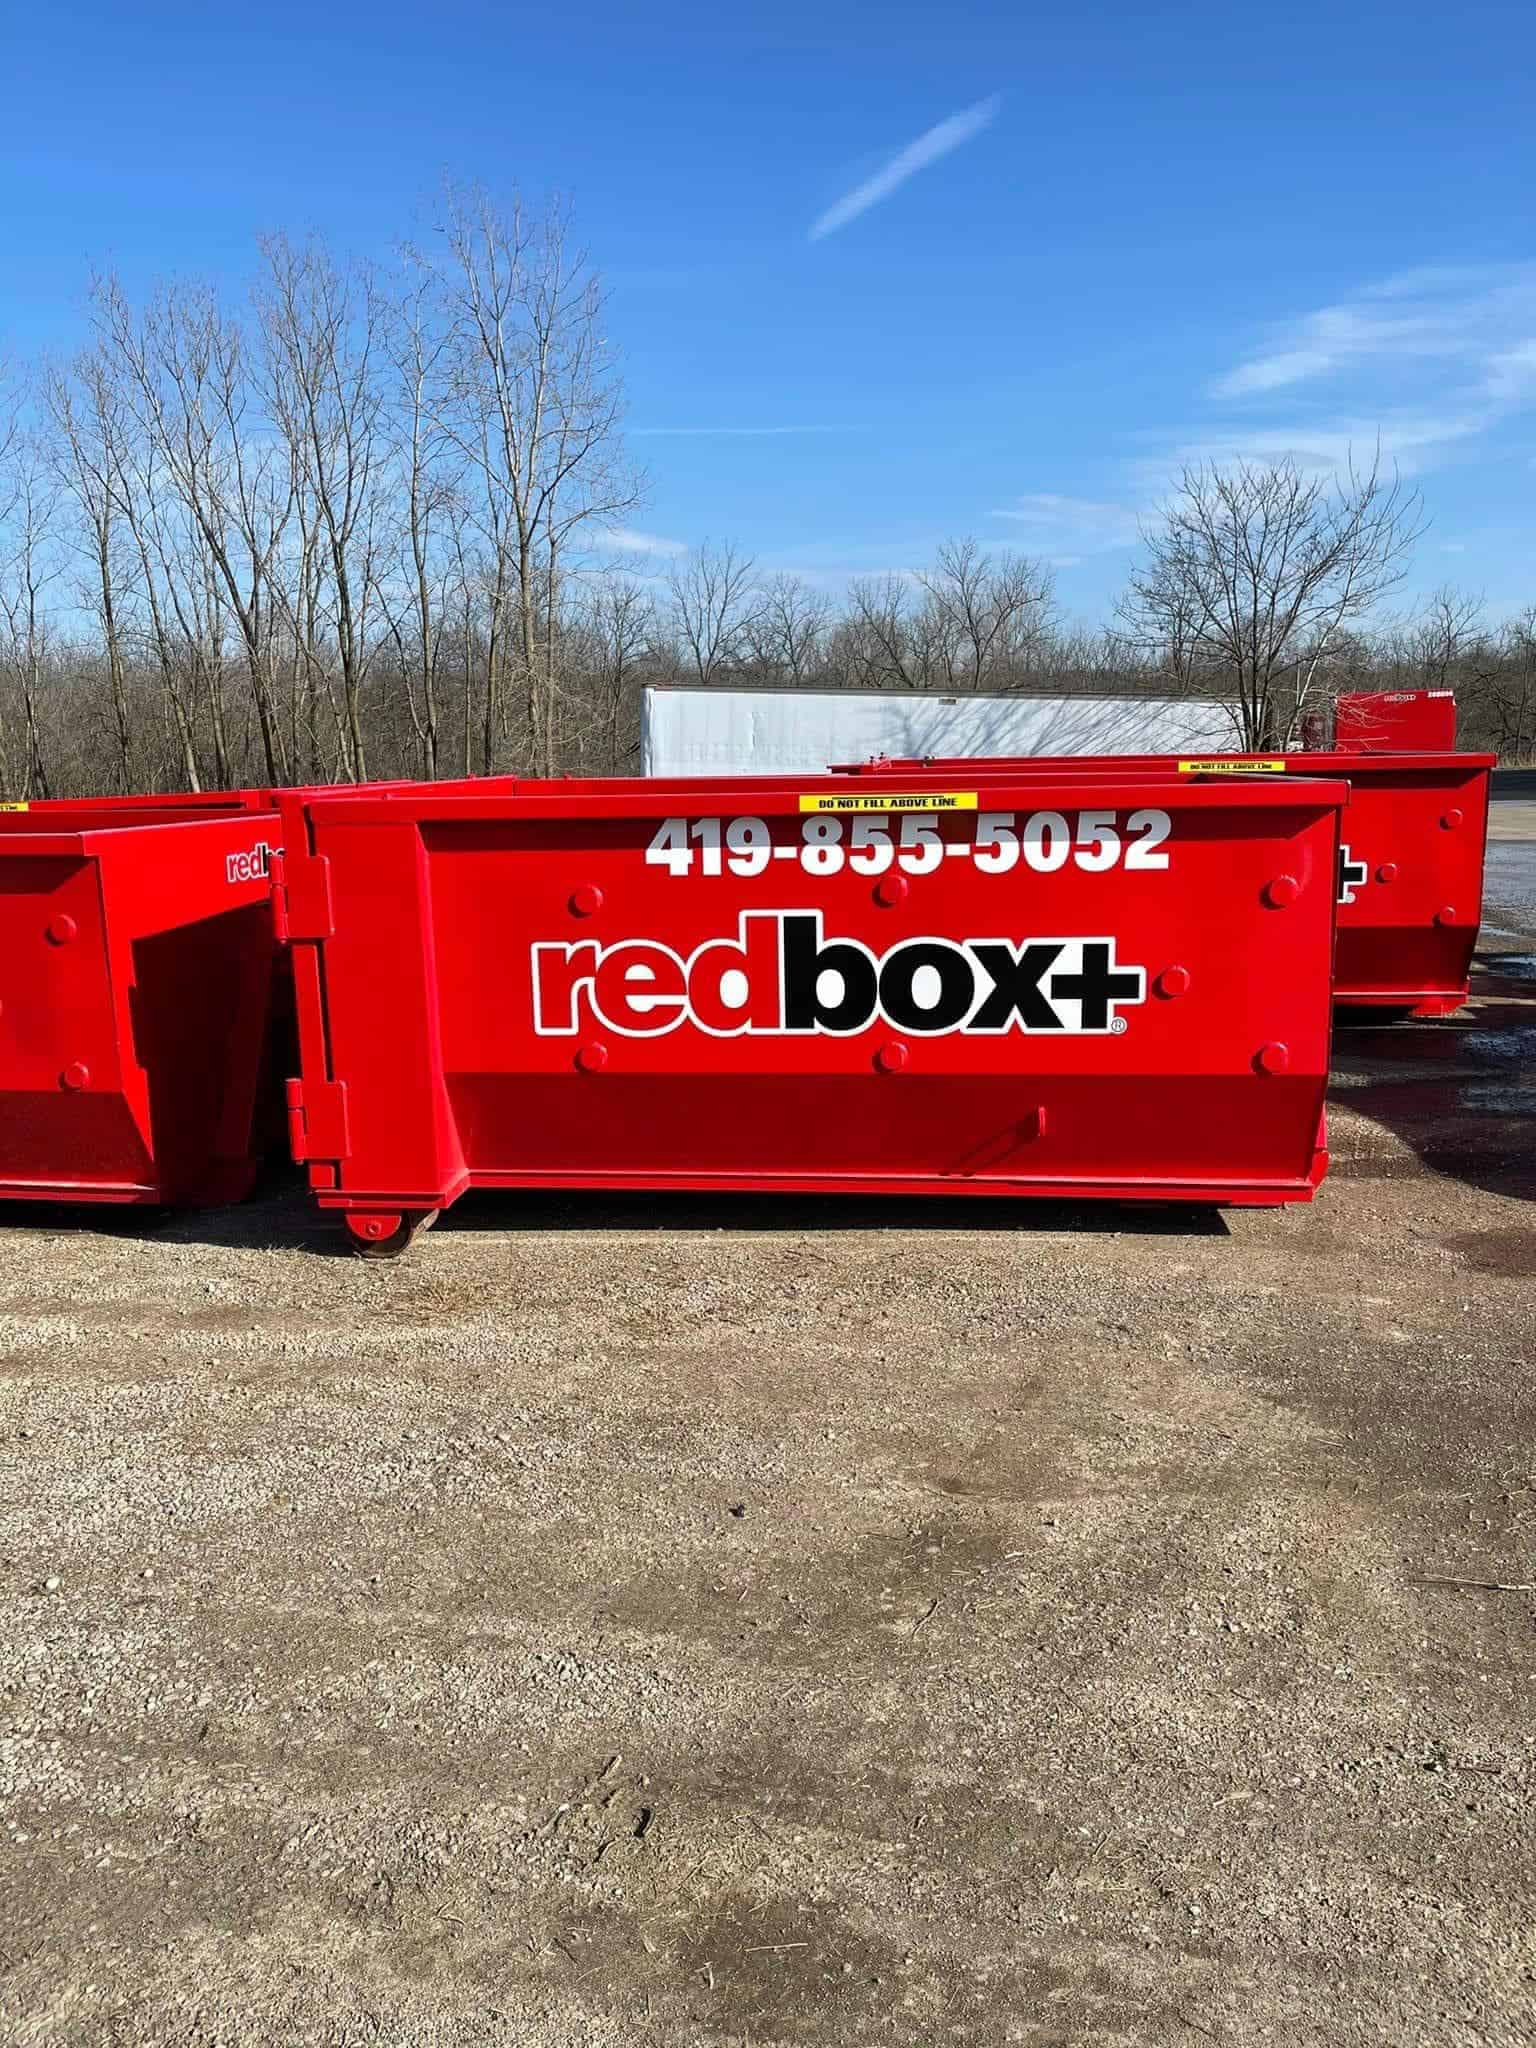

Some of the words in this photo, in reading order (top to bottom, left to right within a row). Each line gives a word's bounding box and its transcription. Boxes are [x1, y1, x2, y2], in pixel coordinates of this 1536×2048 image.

[818, 799, 834, 809] DO
[837, 799, 860, 809] NOT
[863, 798, 885, 808] FILL
[890, 798, 929, 808] ABOVE
[932, 797, 957, 807] LINE
[644, 809, 1172, 877] 419-855-5052
